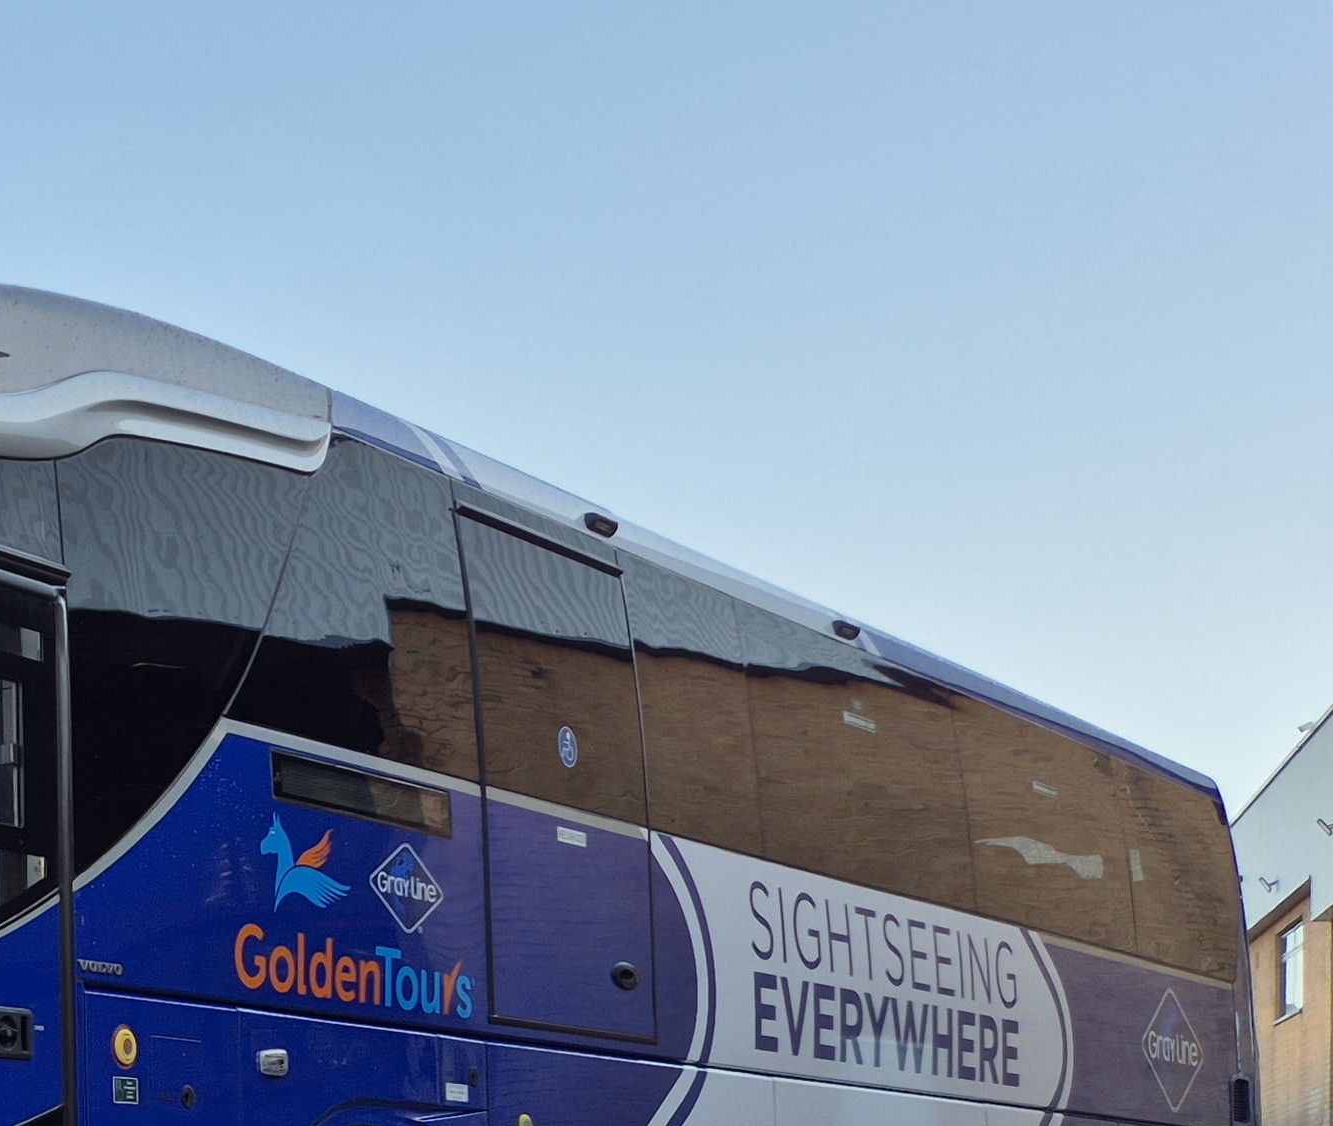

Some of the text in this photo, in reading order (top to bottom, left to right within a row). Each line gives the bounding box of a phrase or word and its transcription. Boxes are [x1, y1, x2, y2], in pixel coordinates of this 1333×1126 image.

[77, 959, 123, 976] VOLVO
[749, 881, 1018, 1009] SIGHTSEEING
[753, 971, 1020, 1088] EVERYWHERE
